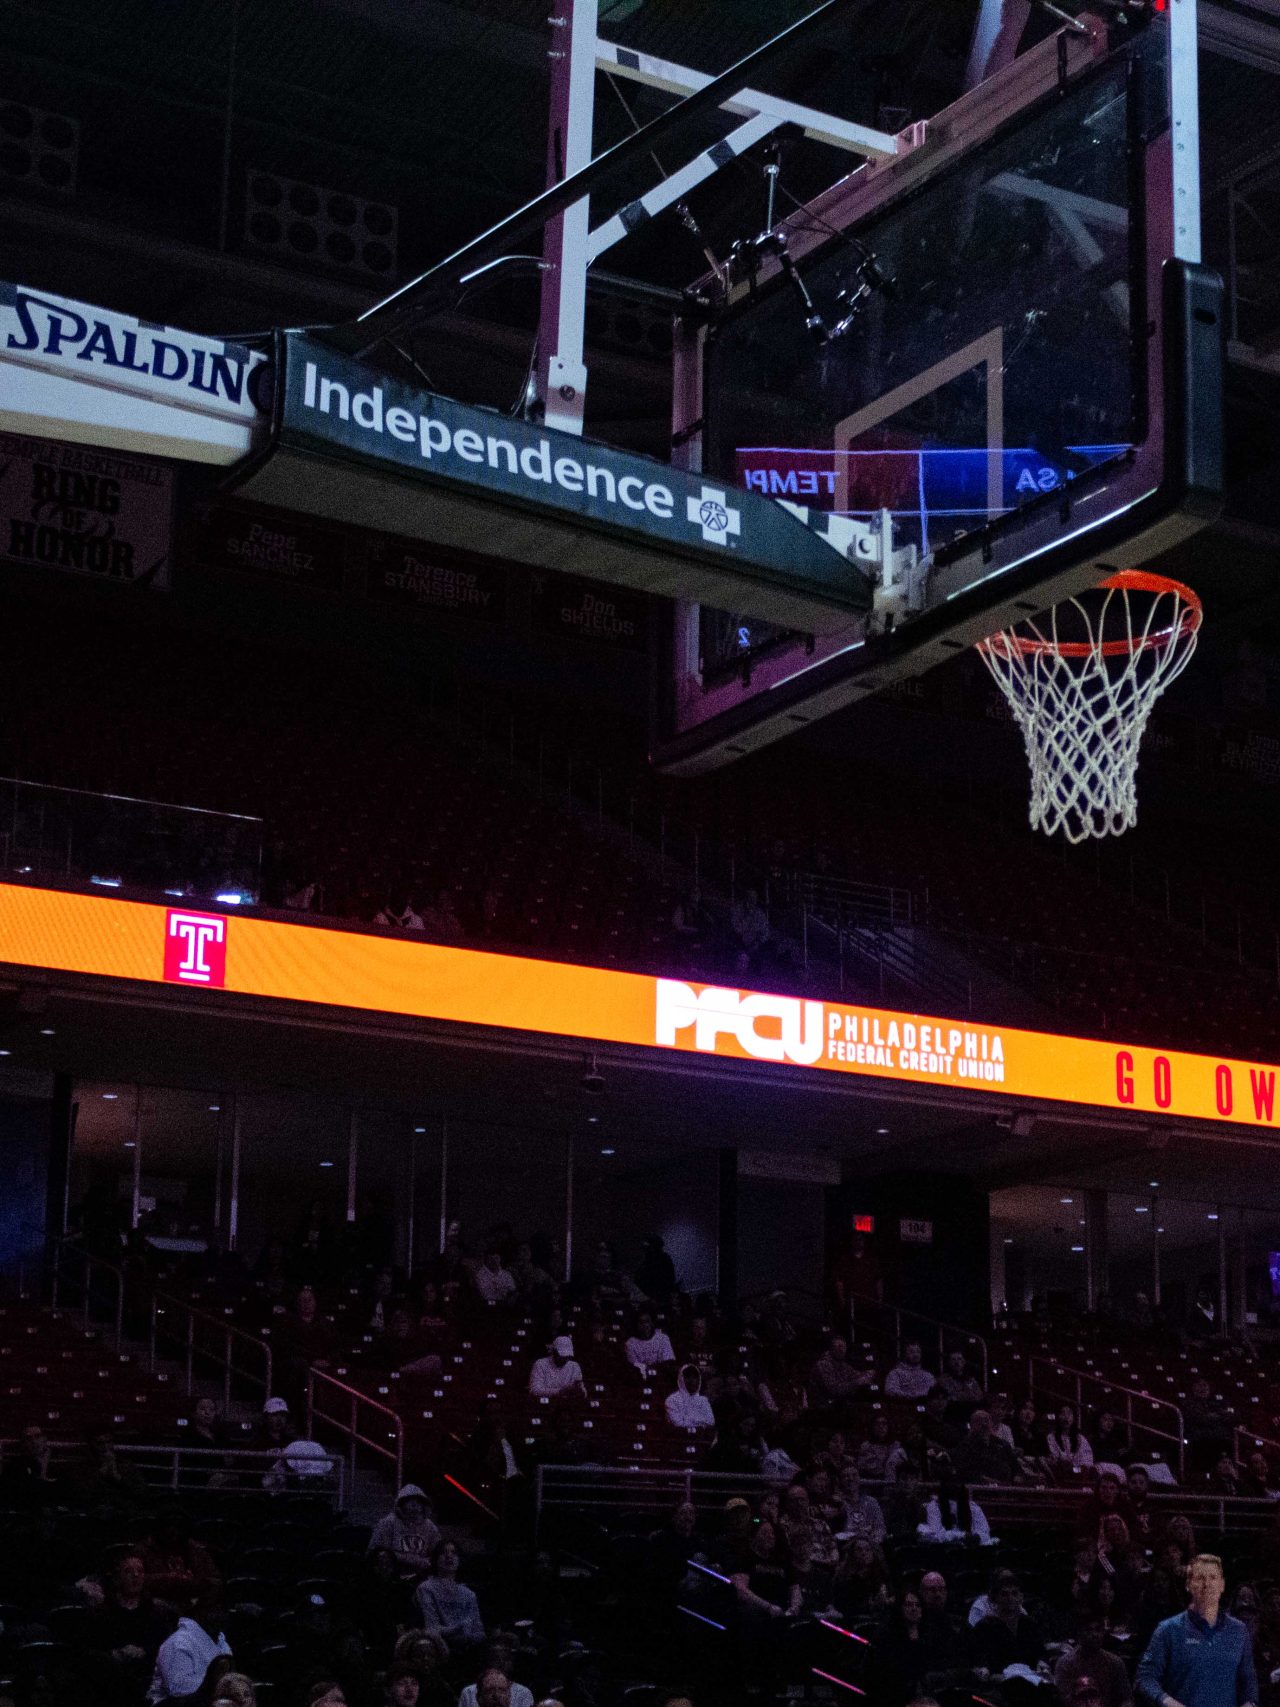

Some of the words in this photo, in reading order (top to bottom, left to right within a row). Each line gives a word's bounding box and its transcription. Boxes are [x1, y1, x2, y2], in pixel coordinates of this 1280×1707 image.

[303, 362, 674, 518] Independence
[32, 463, 120, 515] RING
[8, 519, 134, 579] HONOR
[656, 977, 823, 1065] PFCU
[828, 1012, 1004, 1062] PHILADELPHIA
[828, 1040, 894, 1068] FEDERAL
[900, 1050, 953, 1075] CREDIT
[958, 1056, 1005, 1082] UNION
[1116, 1051, 1171, 1108] GO
